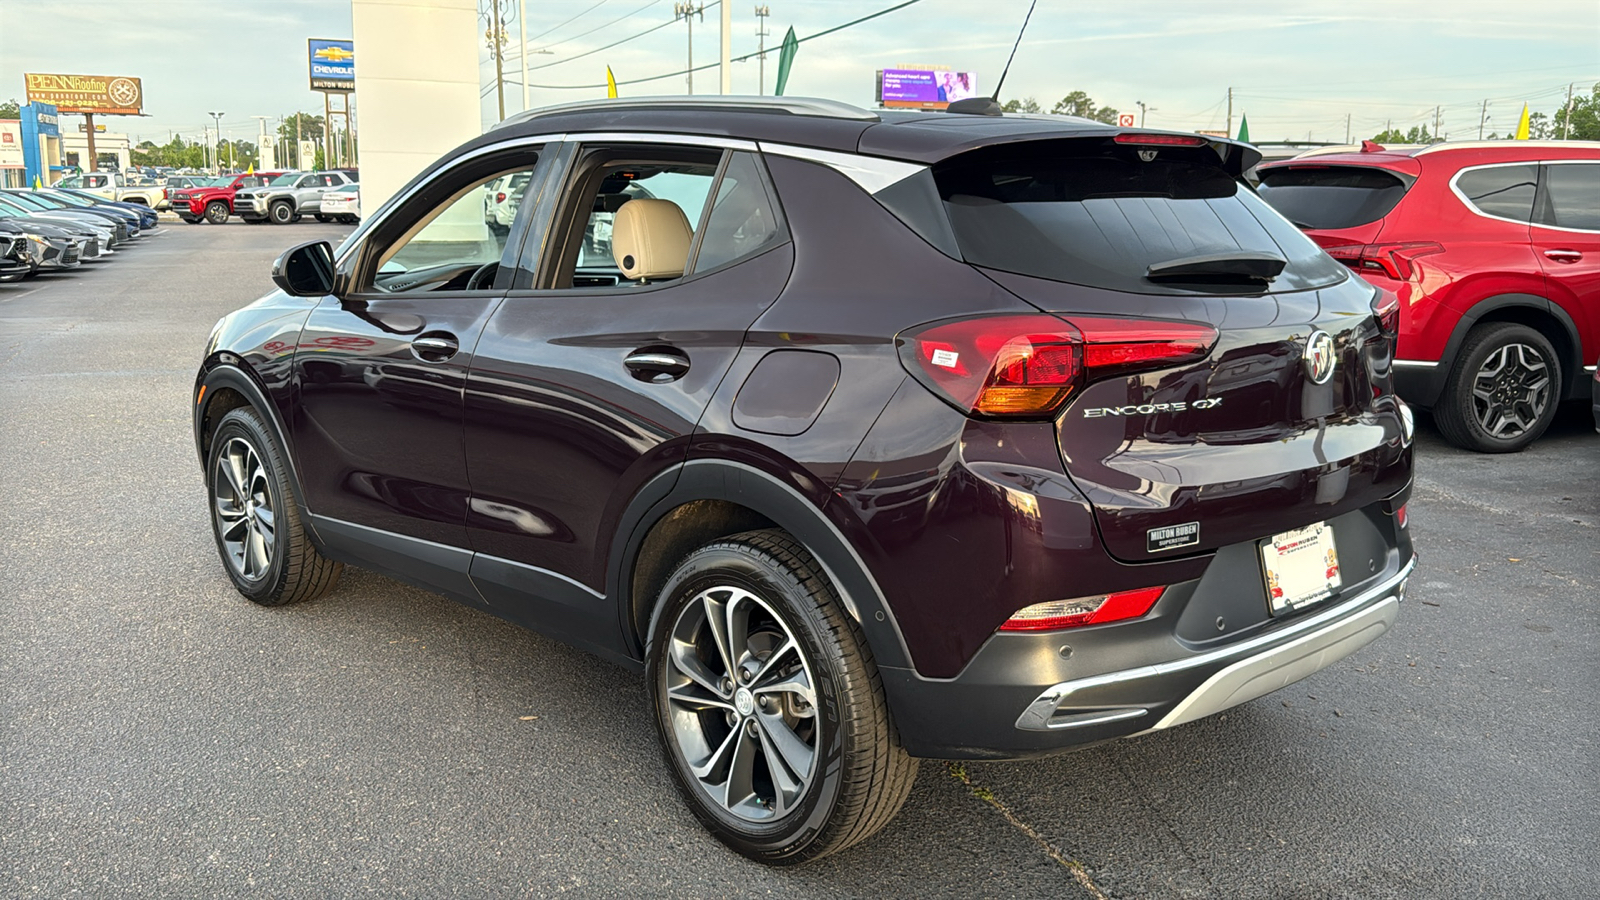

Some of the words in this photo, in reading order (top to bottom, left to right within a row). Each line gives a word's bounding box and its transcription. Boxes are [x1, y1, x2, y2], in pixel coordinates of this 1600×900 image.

[28, 74, 76, 89] PENN
[75, 77, 107, 93] Roofing
[1083, 402, 1187, 418] ENCORE
[1191, 397, 1223, 410] GX
[1150, 528, 1175, 541] MILTON
[1175, 524, 1197, 537] RUBEN
[1158, 535, 1190, 546] SUPERSTORE
[1277, 541, 1298, 552] MILTON
[1298, 535, 1318, 545] RUBEN
